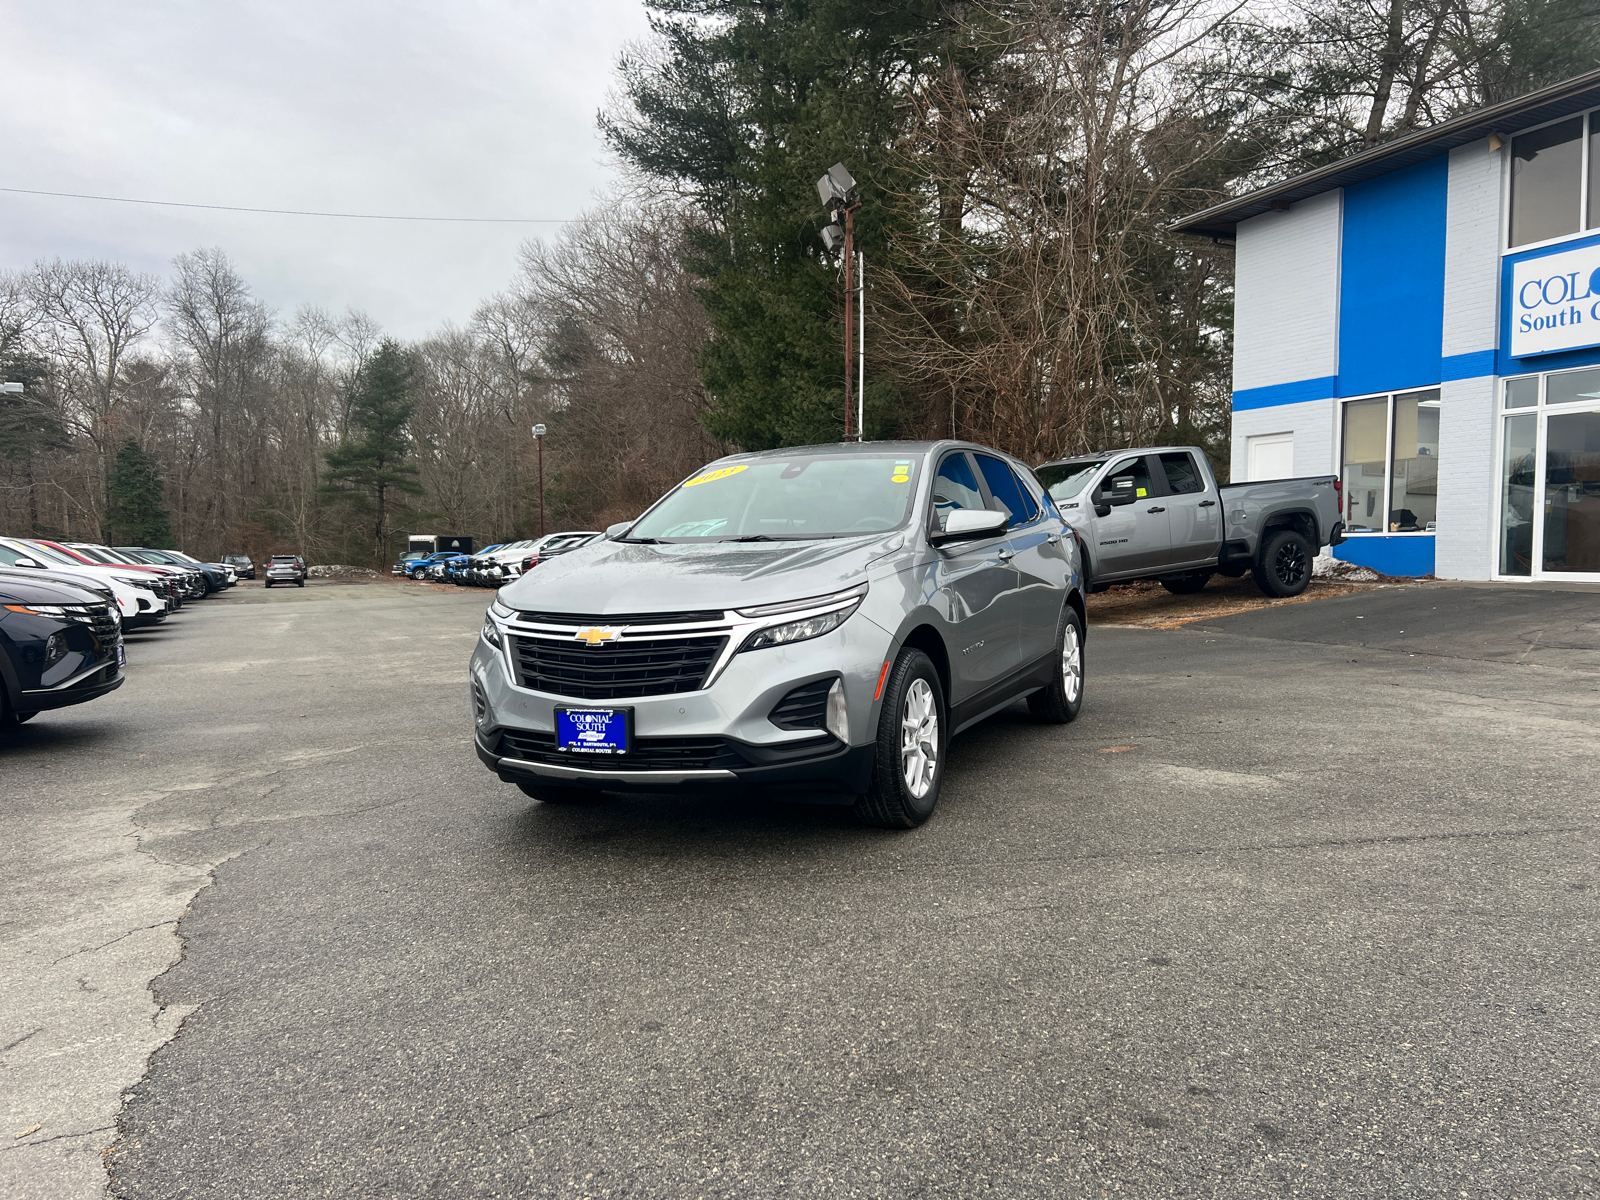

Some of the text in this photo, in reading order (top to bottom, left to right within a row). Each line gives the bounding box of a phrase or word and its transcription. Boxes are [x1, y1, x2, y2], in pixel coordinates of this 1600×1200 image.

[1519, 305, 1582, 334] South
[569, 714, 612, 723] COLONIAL
[576, 723, 605, 731] SOUTH
